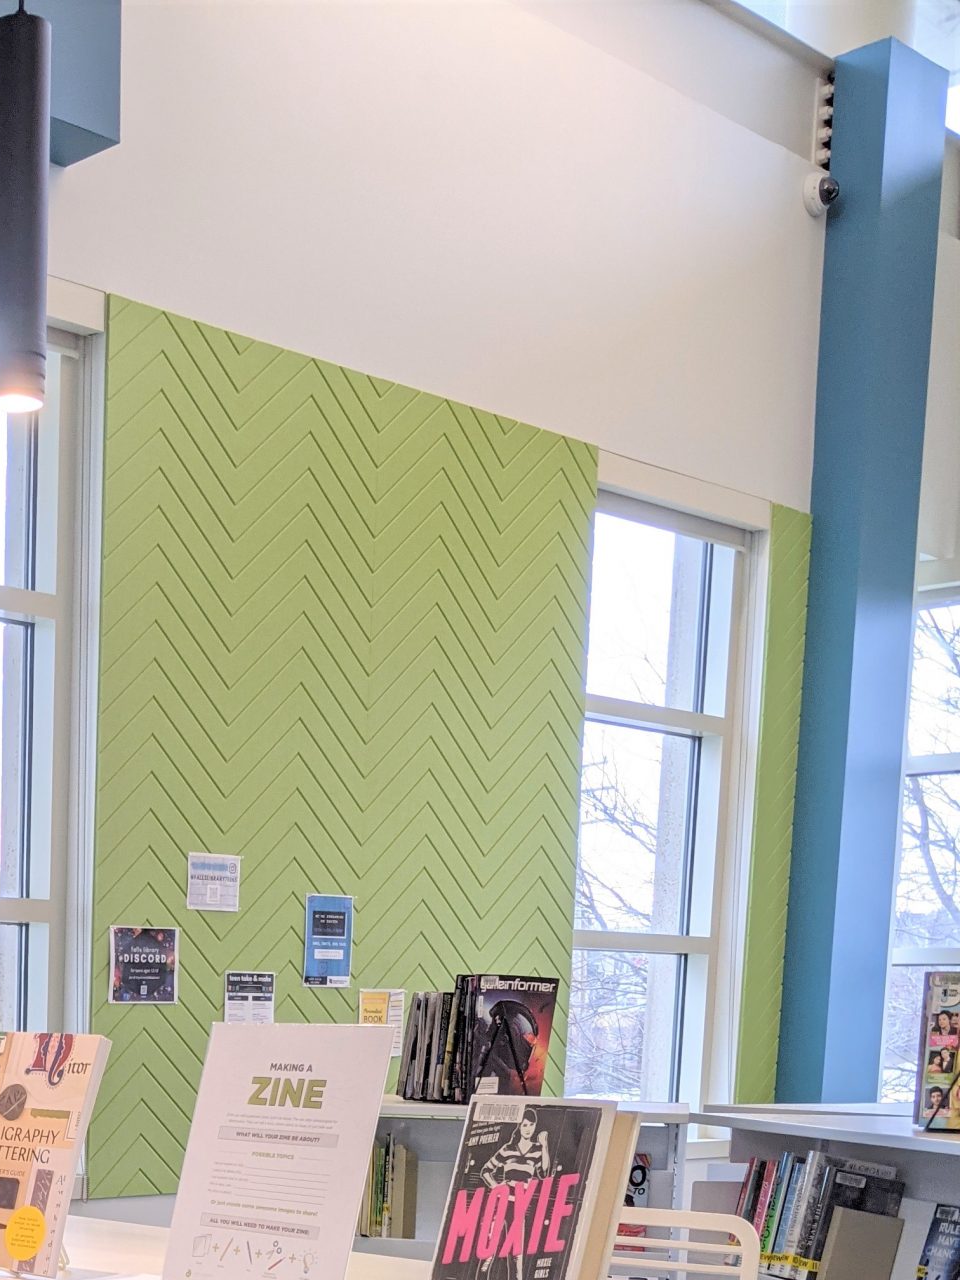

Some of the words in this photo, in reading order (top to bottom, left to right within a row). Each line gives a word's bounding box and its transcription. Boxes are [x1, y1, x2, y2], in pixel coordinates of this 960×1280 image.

[143, 946, 159, 954] library
[270, 1063, 305, 1072] MAKING
[306, 1064, 313, 1072] A
[248, 1076, 327, 1109] ZINE
[441, 1173, 580, 1265] MOXIE
[536, 1257, 552, 1268] MOXIE
[534, 1269, 550, 1278] GIRLS
